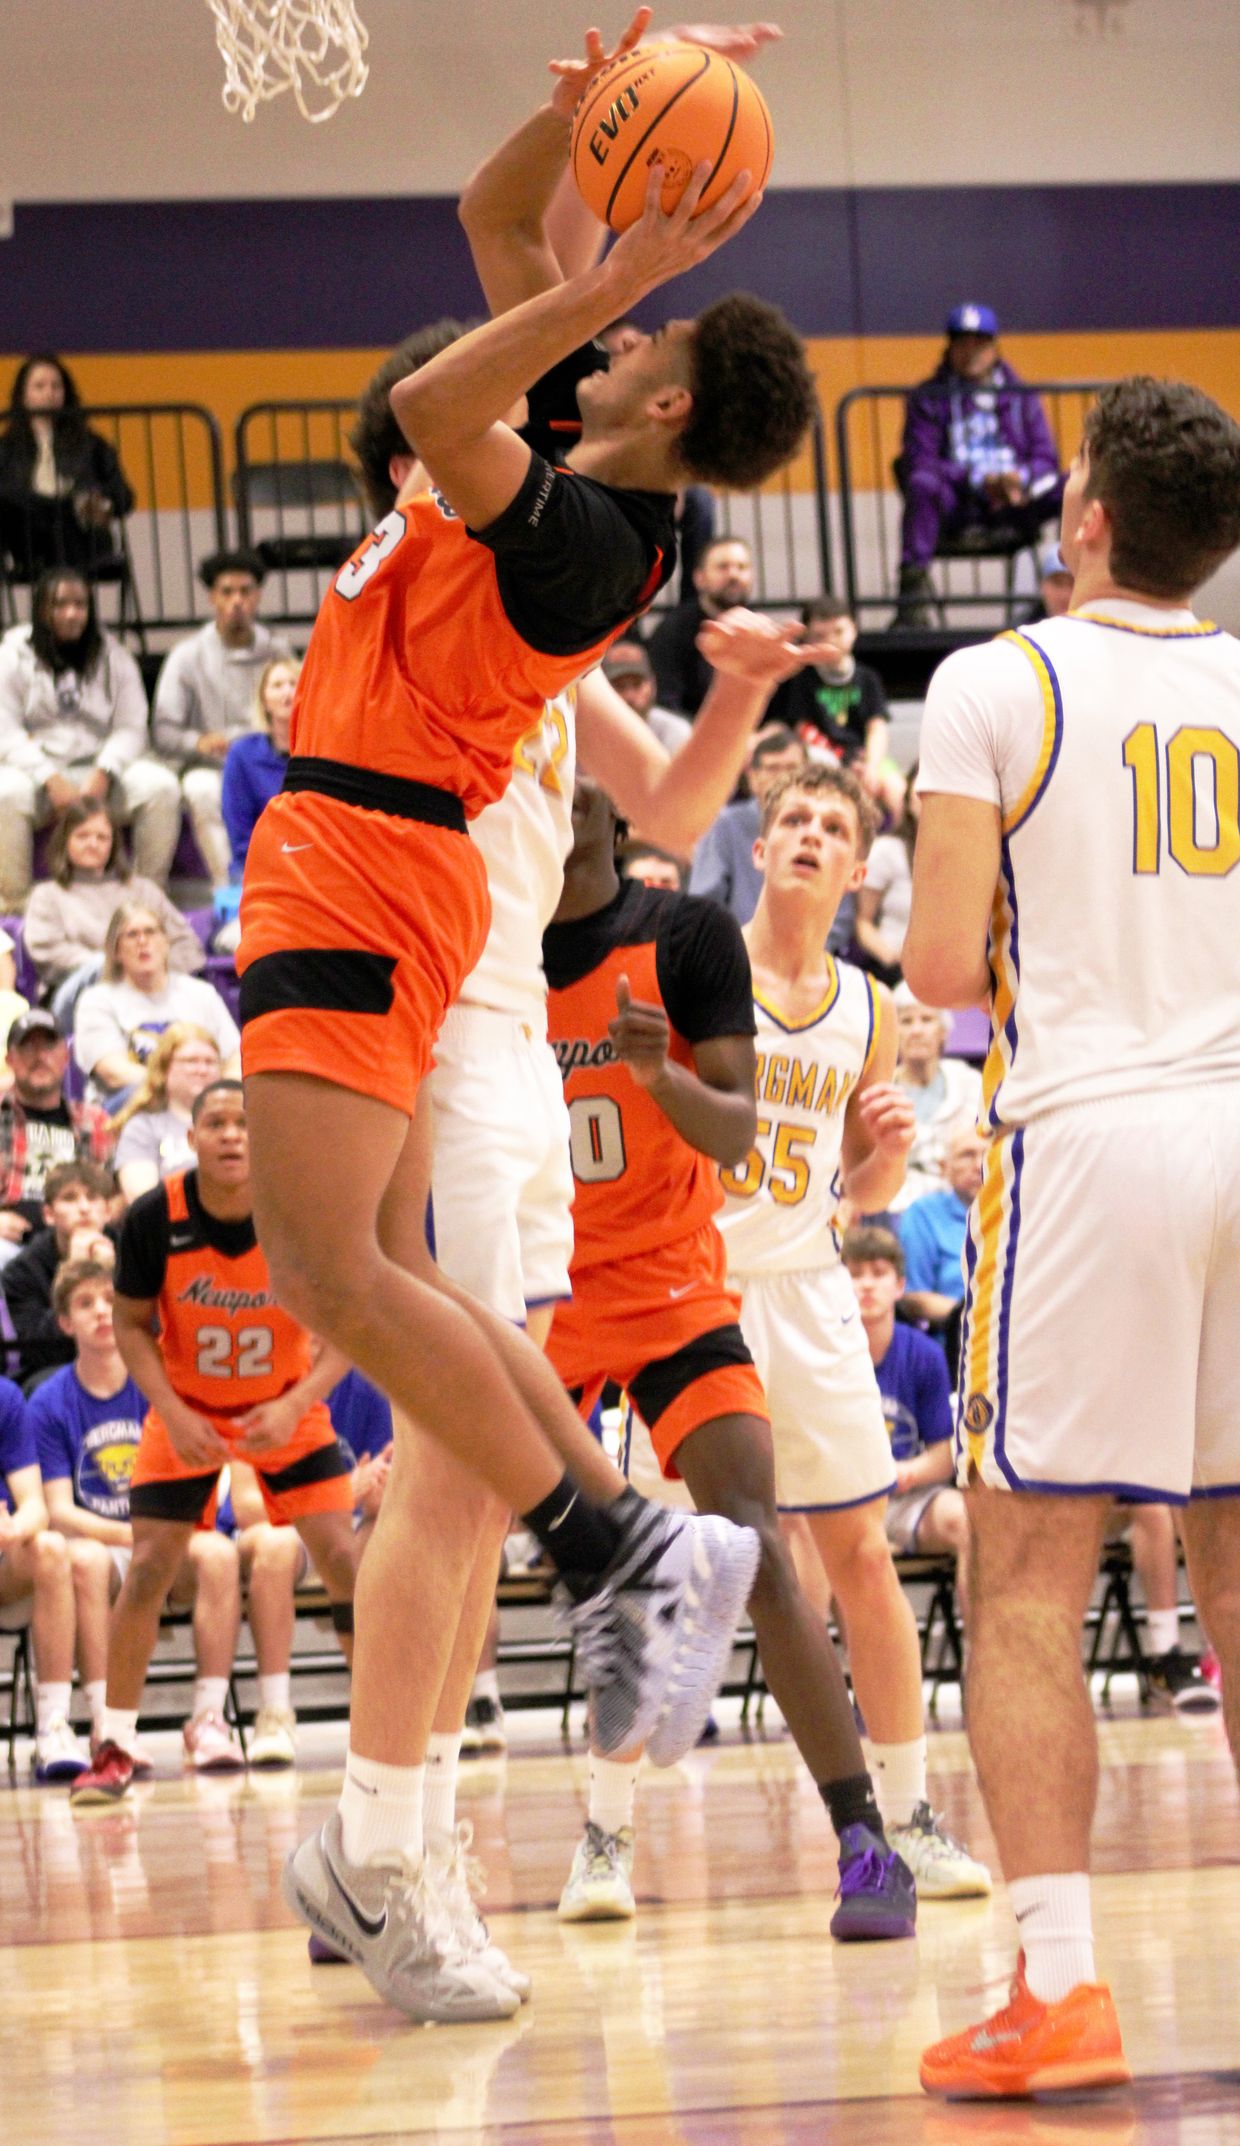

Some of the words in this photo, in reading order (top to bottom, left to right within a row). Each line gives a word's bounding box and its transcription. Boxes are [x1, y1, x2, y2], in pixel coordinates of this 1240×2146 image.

[588, 85, 640, 167] EVO
[334, 509, 407, 602] 3
[1121, 720, 1240, 878] 10
[567, 1093, 628, 1184] 0
[718, 1118, 817, 1207] 55
[177, 1273, 276, 1317] Newpo
[196, 1324, 274, 1379] 22
[91, 1496, 131, 1516] PANT
